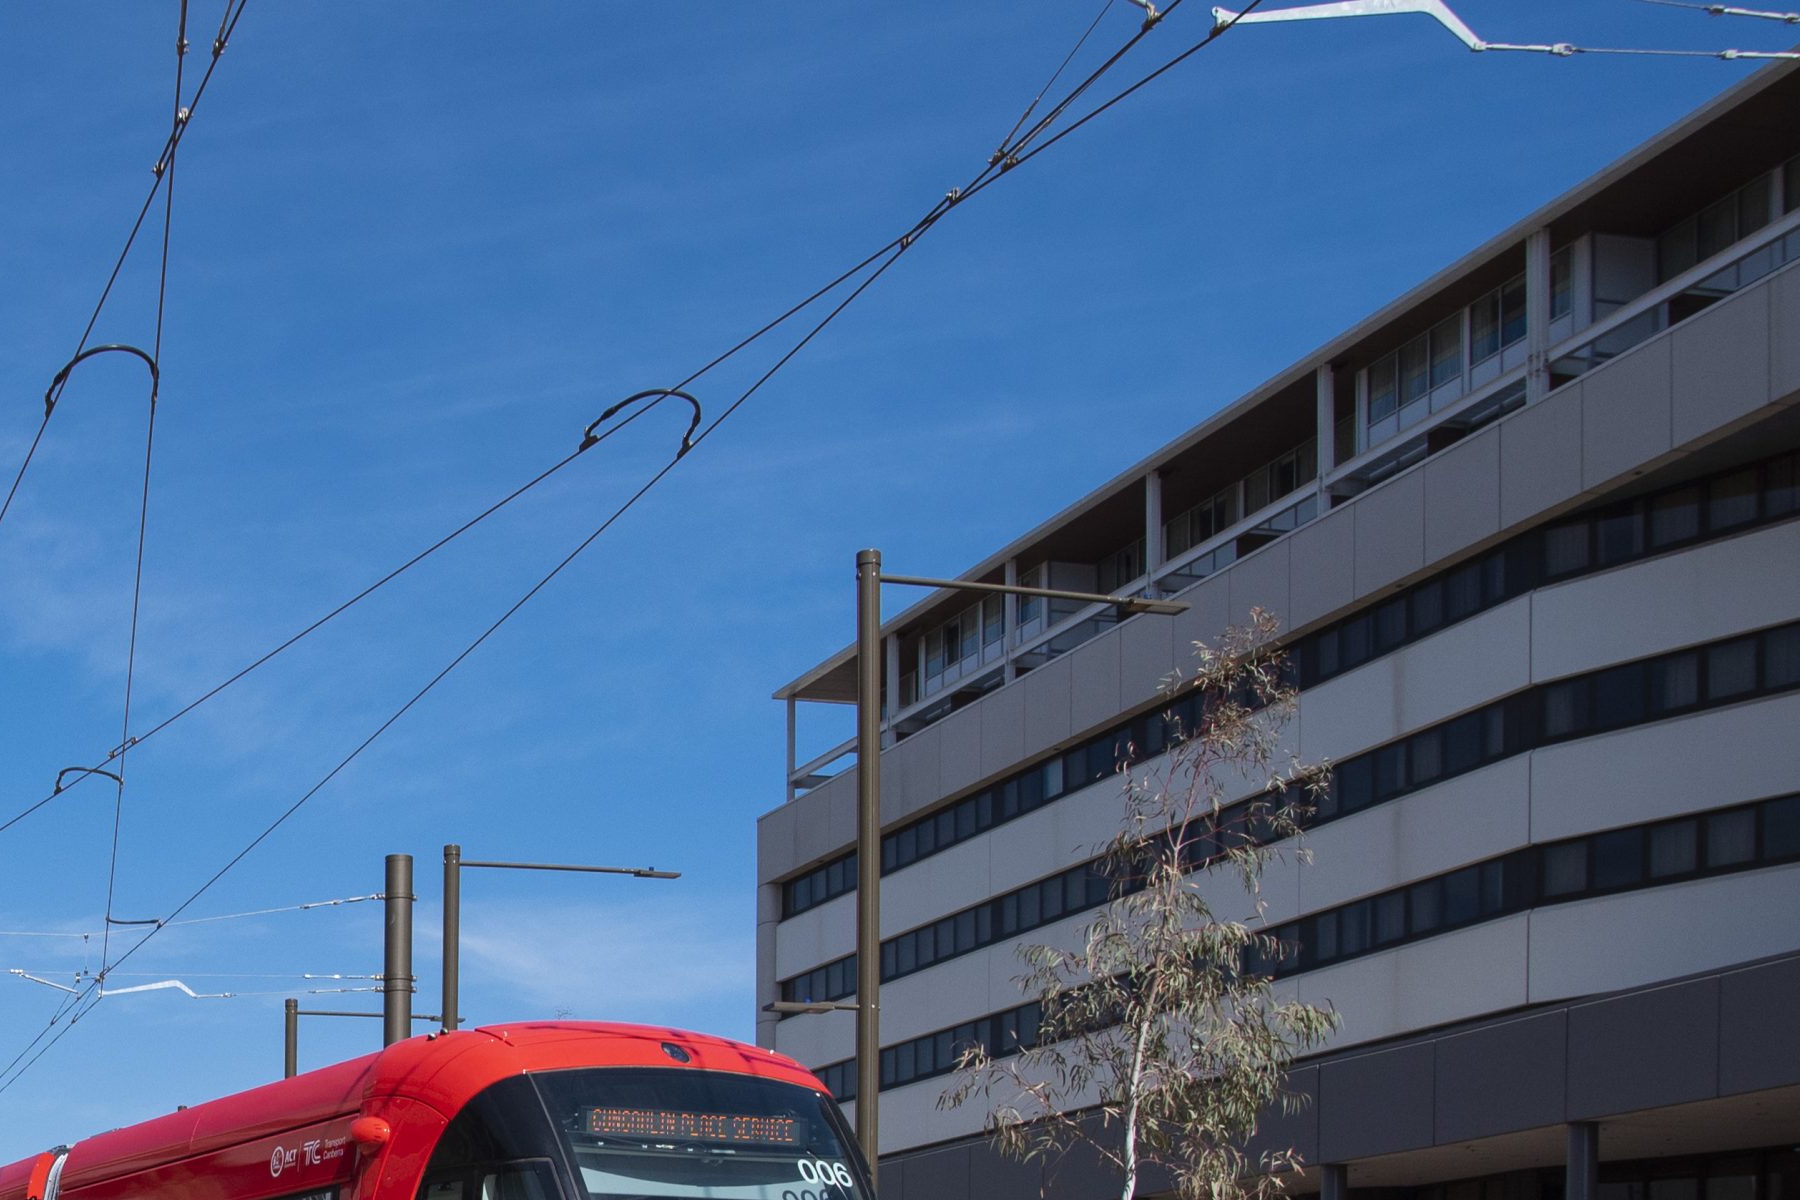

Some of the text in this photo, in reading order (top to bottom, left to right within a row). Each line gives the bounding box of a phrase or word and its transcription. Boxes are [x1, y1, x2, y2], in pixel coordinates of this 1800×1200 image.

[324, 1136, 346, 1149] Transport
[284, 1148, 298, 1164] ACT
[303, 1140, 321, 1166] TC
[323, 1148, 344, 1160] Canberra
[797, 1159, 853, 1188] 006
